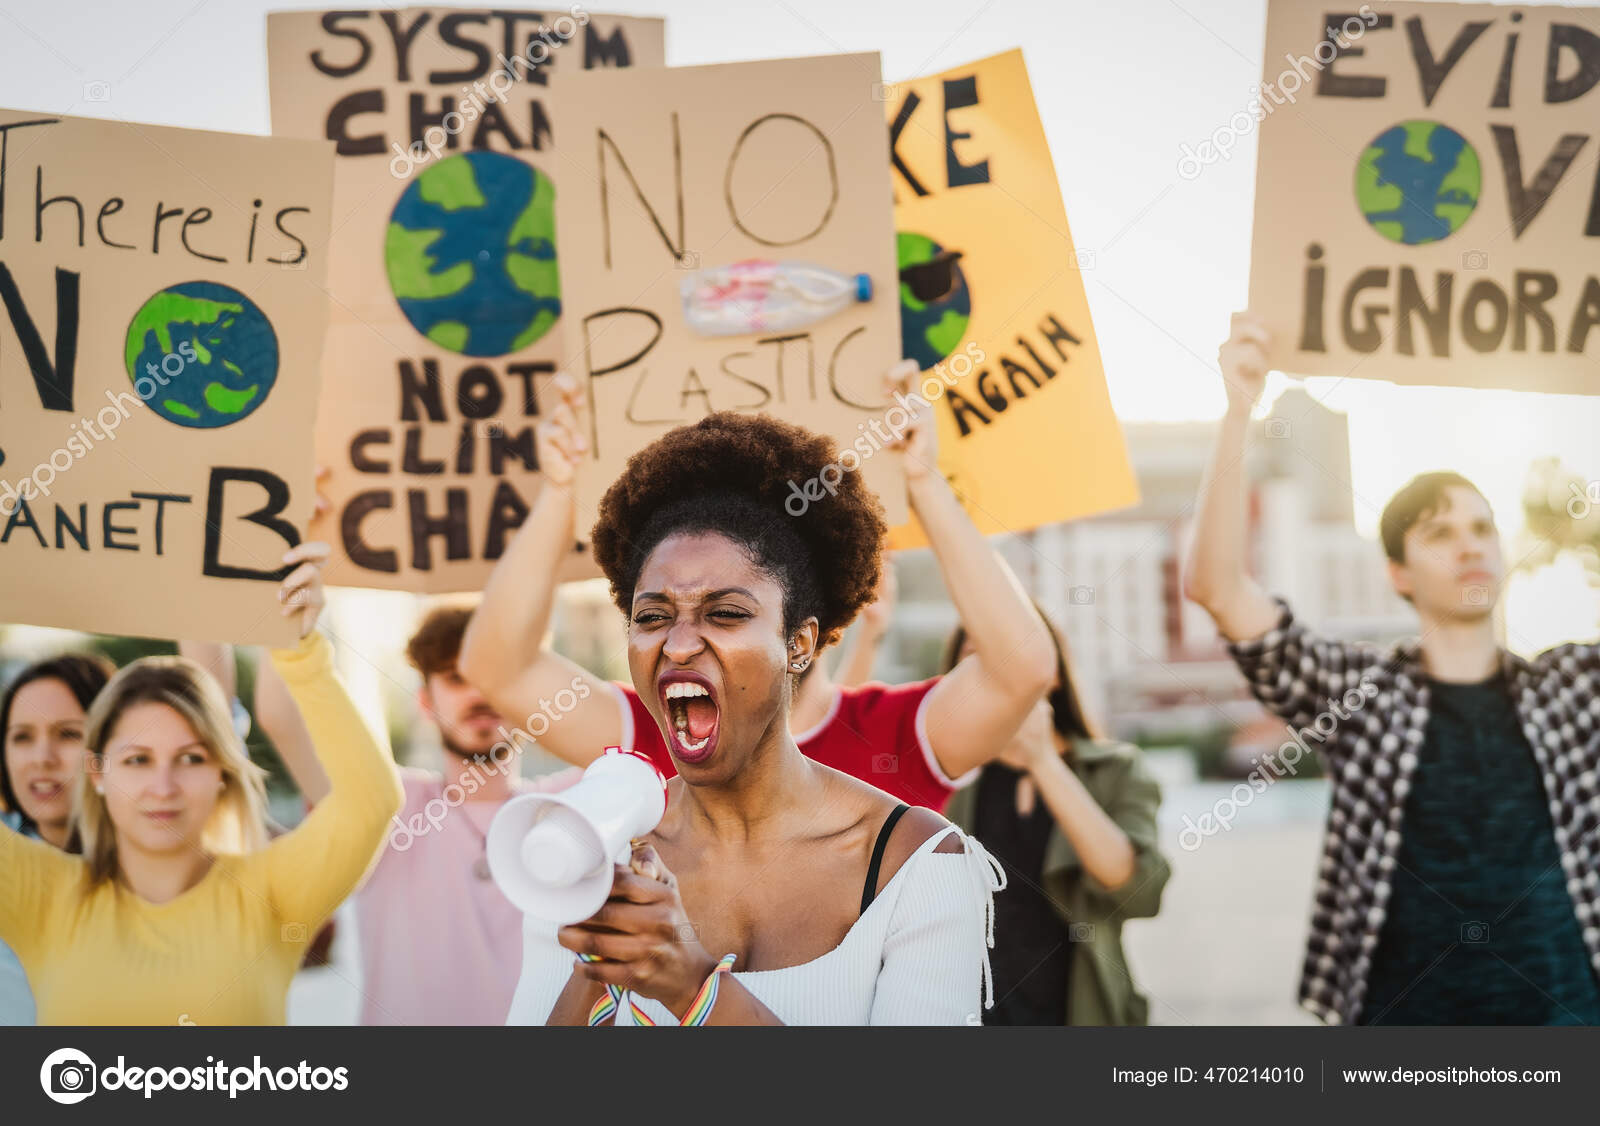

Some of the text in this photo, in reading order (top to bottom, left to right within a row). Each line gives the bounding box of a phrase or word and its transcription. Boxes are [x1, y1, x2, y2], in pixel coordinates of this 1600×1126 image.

[309, 10, 633, 85] SYSTEM
[247, 199, 310, 264] is
[597, 111, 839, 270] NO
[396, 357, 557, 422] NOT
[583, 306, 890, 460] PLASTIC
[943, 313, 1084, 438] AGAIN
[203, 466, 306, 581] B
